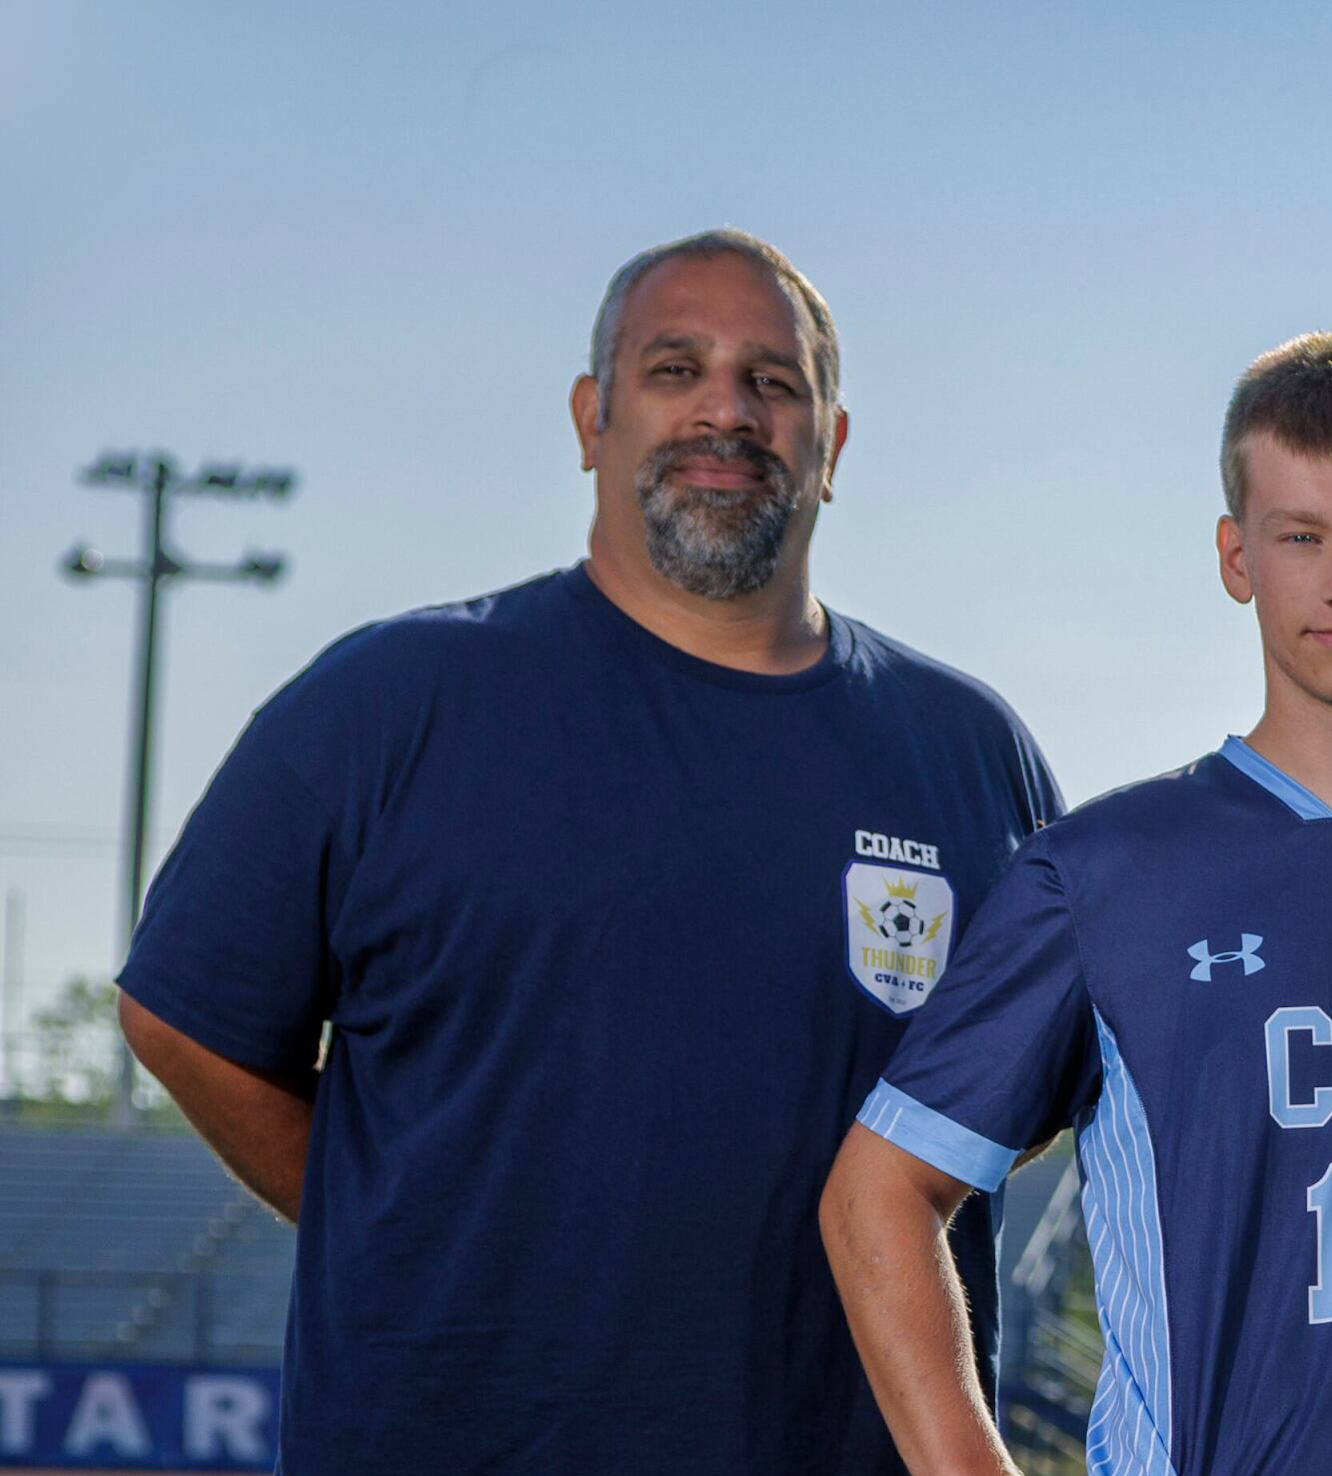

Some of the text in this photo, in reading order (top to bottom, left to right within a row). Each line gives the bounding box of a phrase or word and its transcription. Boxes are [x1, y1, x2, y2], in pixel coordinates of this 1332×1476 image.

[854, 829, 941, 870] COACH
[862, 946, 937, 980] THUNDER
[874, 973, 925, 992] CVA FC
